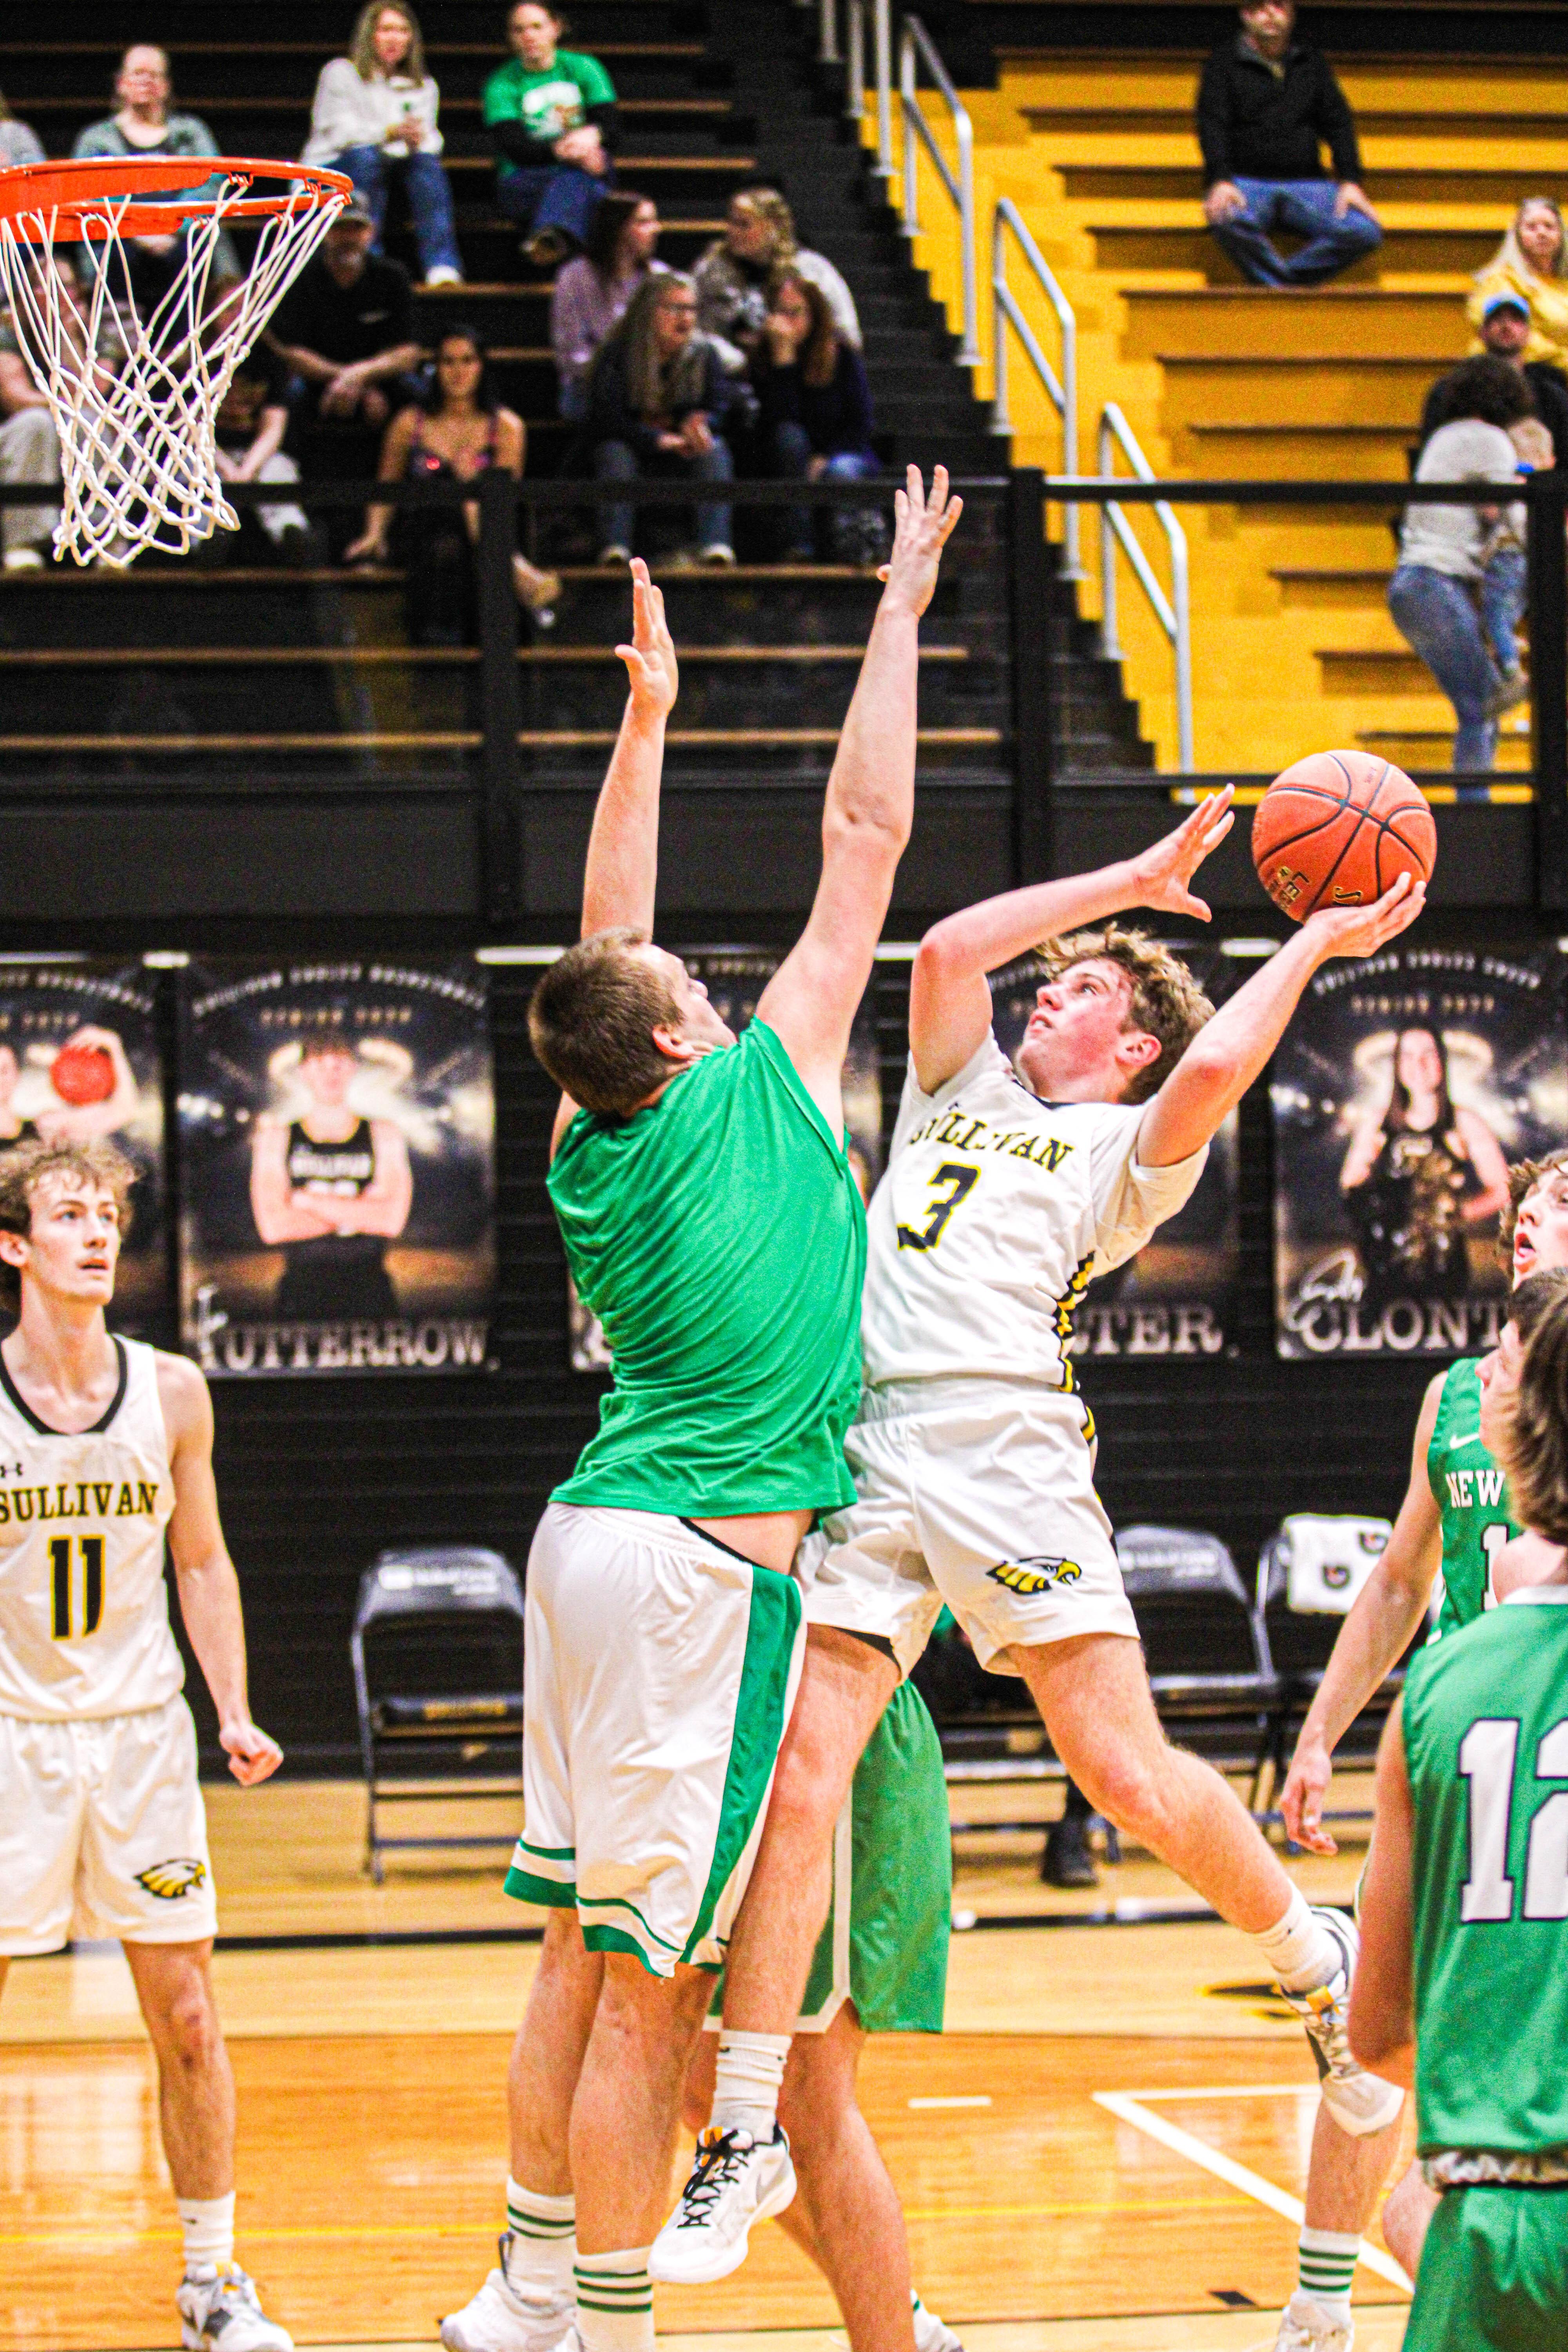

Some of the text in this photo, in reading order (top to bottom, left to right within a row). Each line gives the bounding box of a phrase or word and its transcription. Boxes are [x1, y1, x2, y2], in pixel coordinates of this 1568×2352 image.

[897, 1161, 982, 1252] 3
[0, 1480, 159, 1524] SULLIVAN
[1445, 1469, 1506, 1509] NEW
[47, 1534, 106, 1641] 11
[1457, 1717, 1568, 1923] 12
